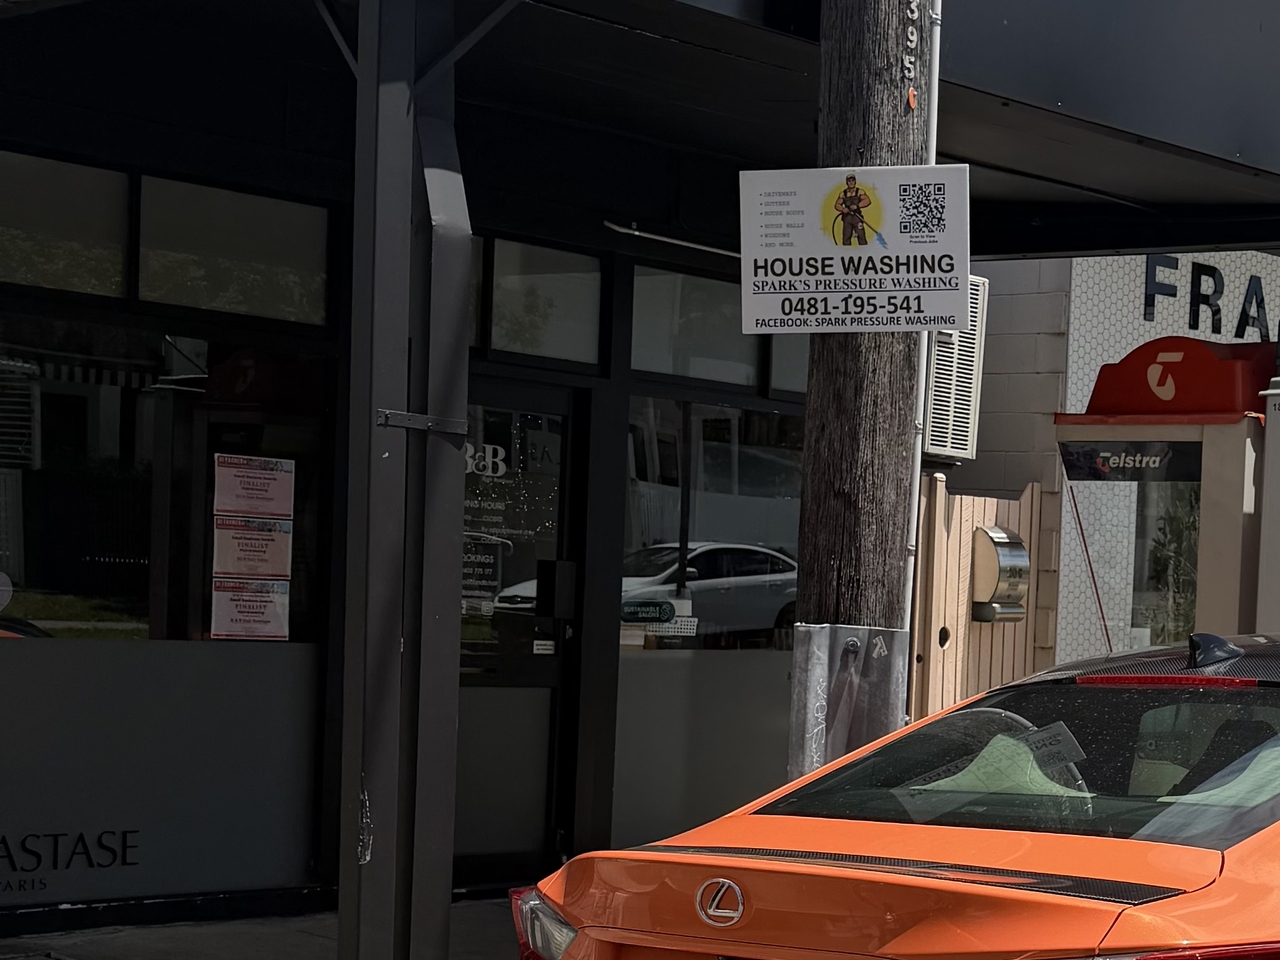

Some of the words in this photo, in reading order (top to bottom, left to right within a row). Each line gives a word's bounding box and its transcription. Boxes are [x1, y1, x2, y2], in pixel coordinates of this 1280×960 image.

[754, 256, 835, 277] HOUSE
[840, 254, 955, 276] WASHING
[752, 279, 811, 292] SPARK'S
[815, 278, 887, 291] PRESSURE
[891, 276, 959, 289] WASHING
[781, 294, 925, 316] 0481-195-541
[755, 317, 812, 328] FACEBOOK:
[815, 317, 847, 327] SPARK
[850, 316, 902, 326] PRESSURE
[905, 315, 956, 326] WASHING
[1096, 452, 1160, 473] Telstra
[239, 480, 271, 488] FINALIST
[0, 878, 47, 891] ARIS
